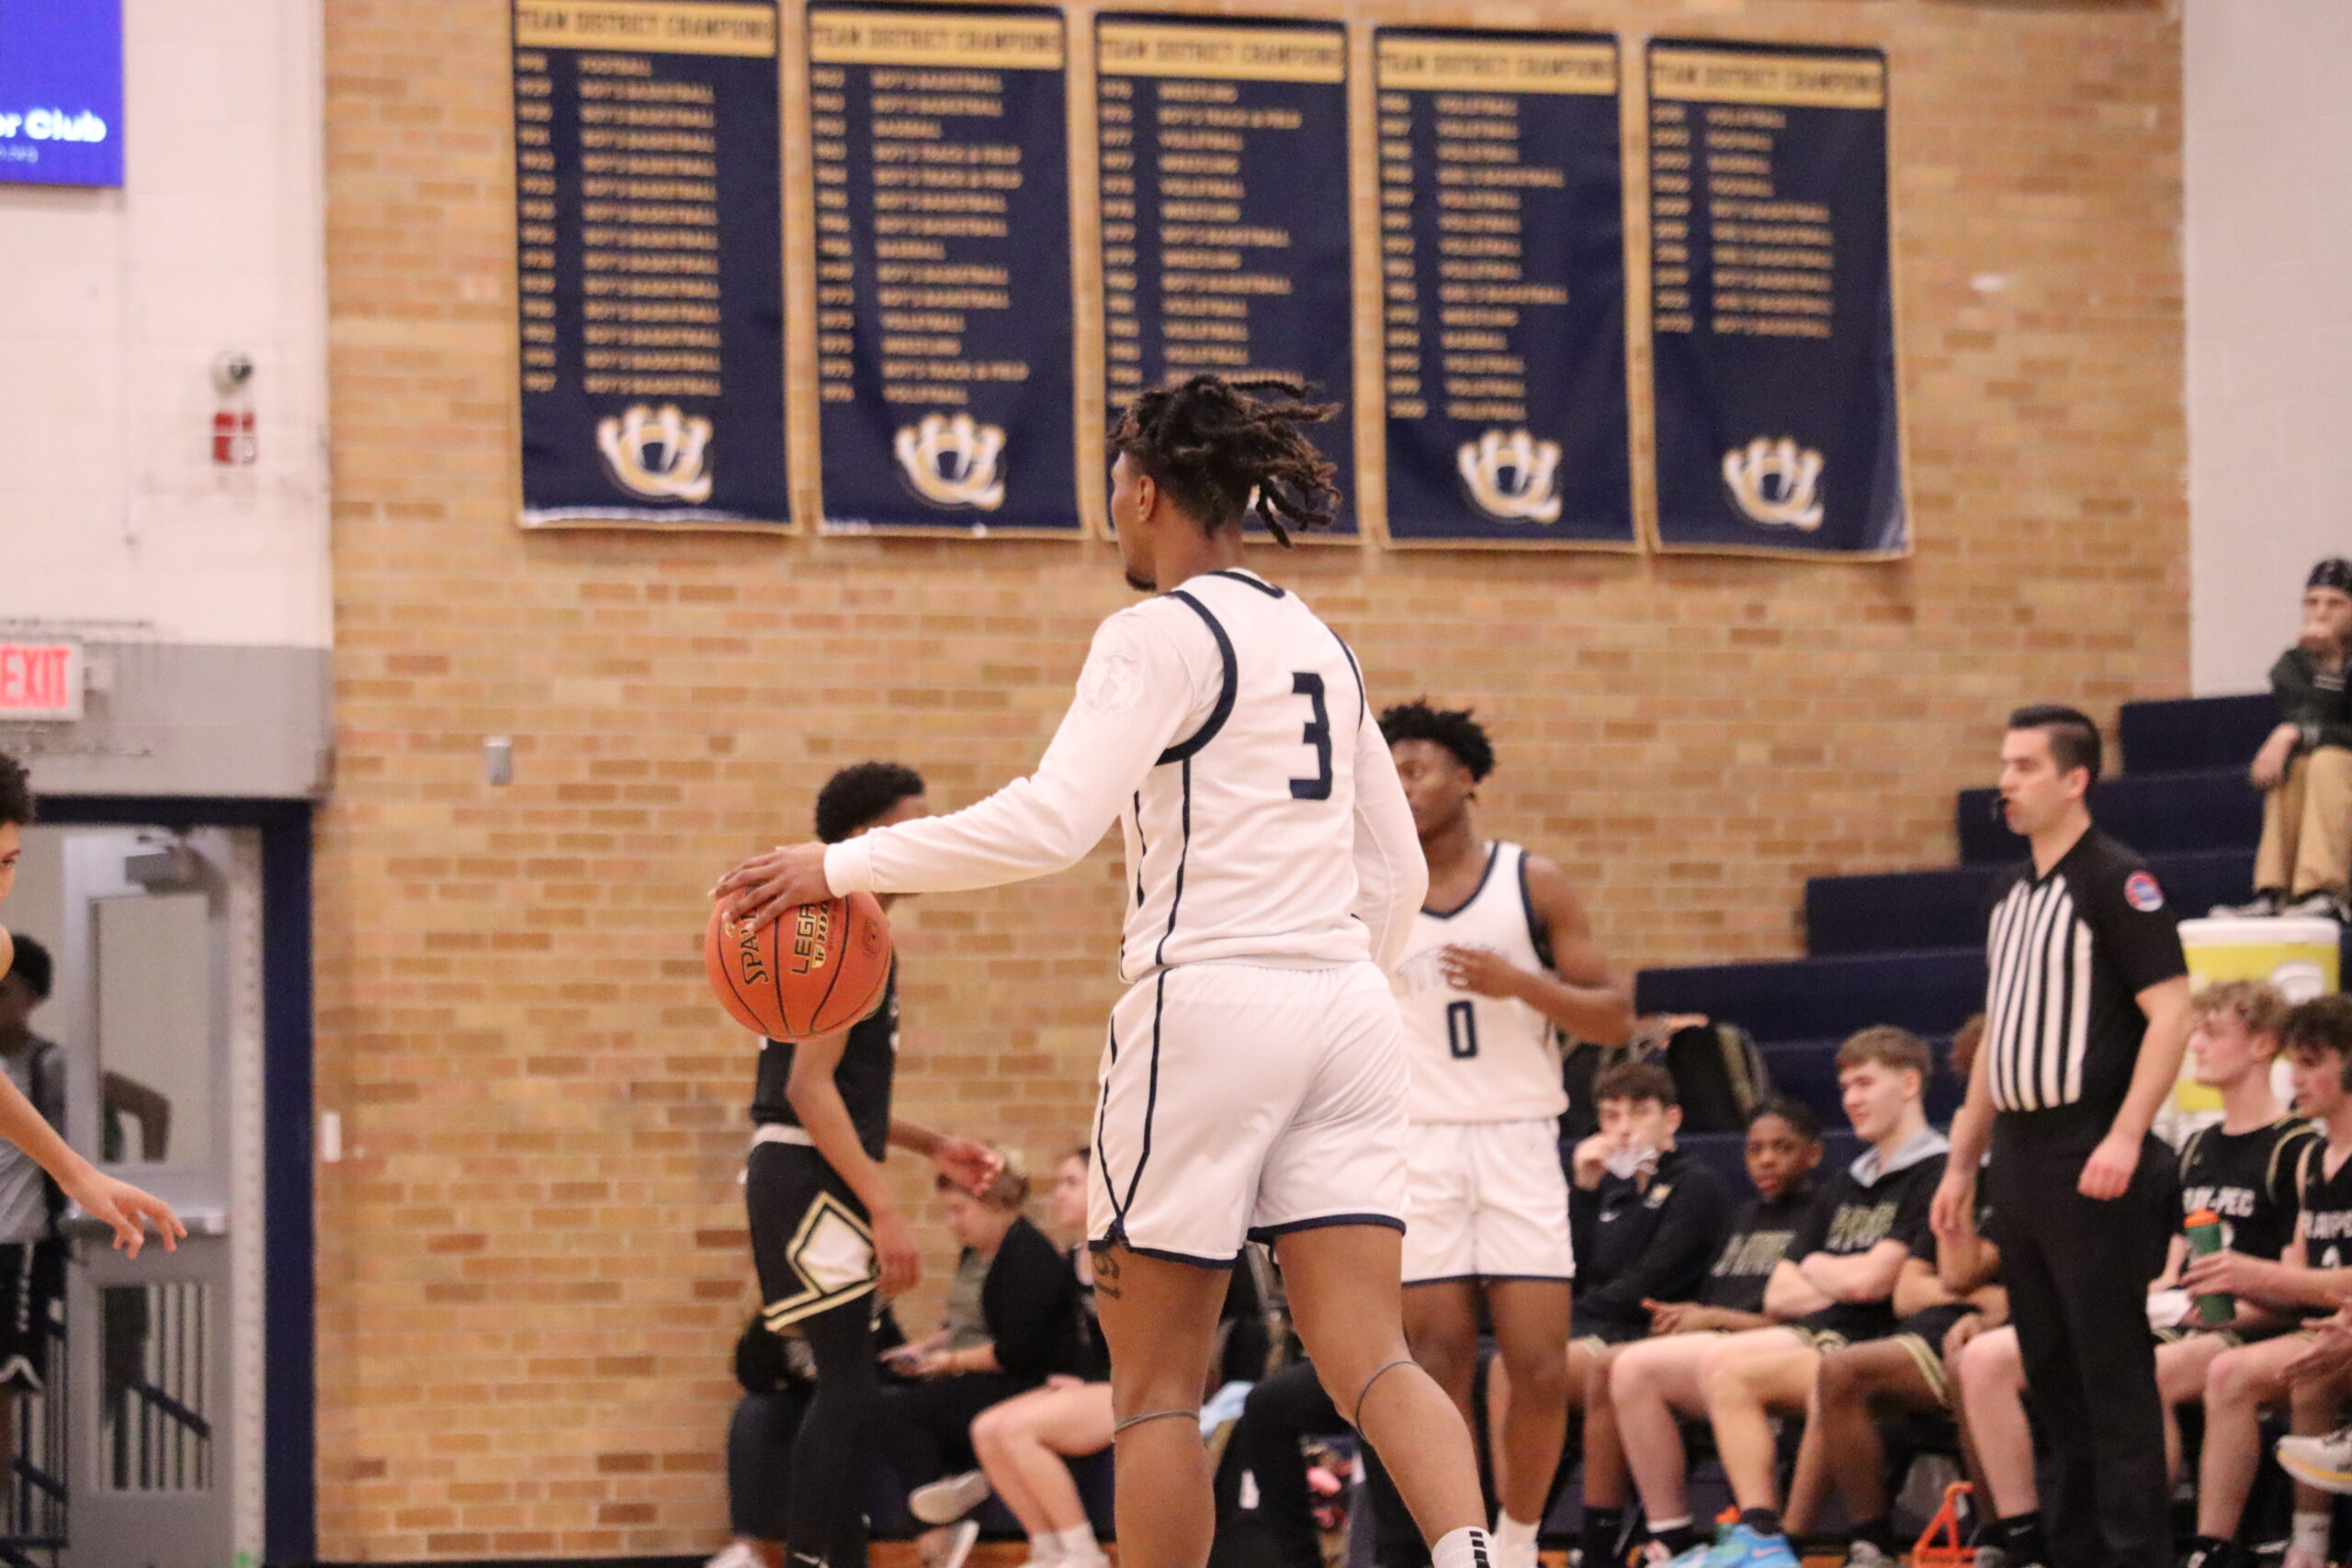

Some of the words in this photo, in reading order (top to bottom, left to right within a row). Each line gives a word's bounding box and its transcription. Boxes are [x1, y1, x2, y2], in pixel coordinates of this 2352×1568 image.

[25, 106, 107, 143] Club
[0, 647, 71, 709] EXIT
[1289, 671, 1333, 801] 3
[791, 903, 817, 975] LEGA
[1447, 1000, 1478, 1060] 0
